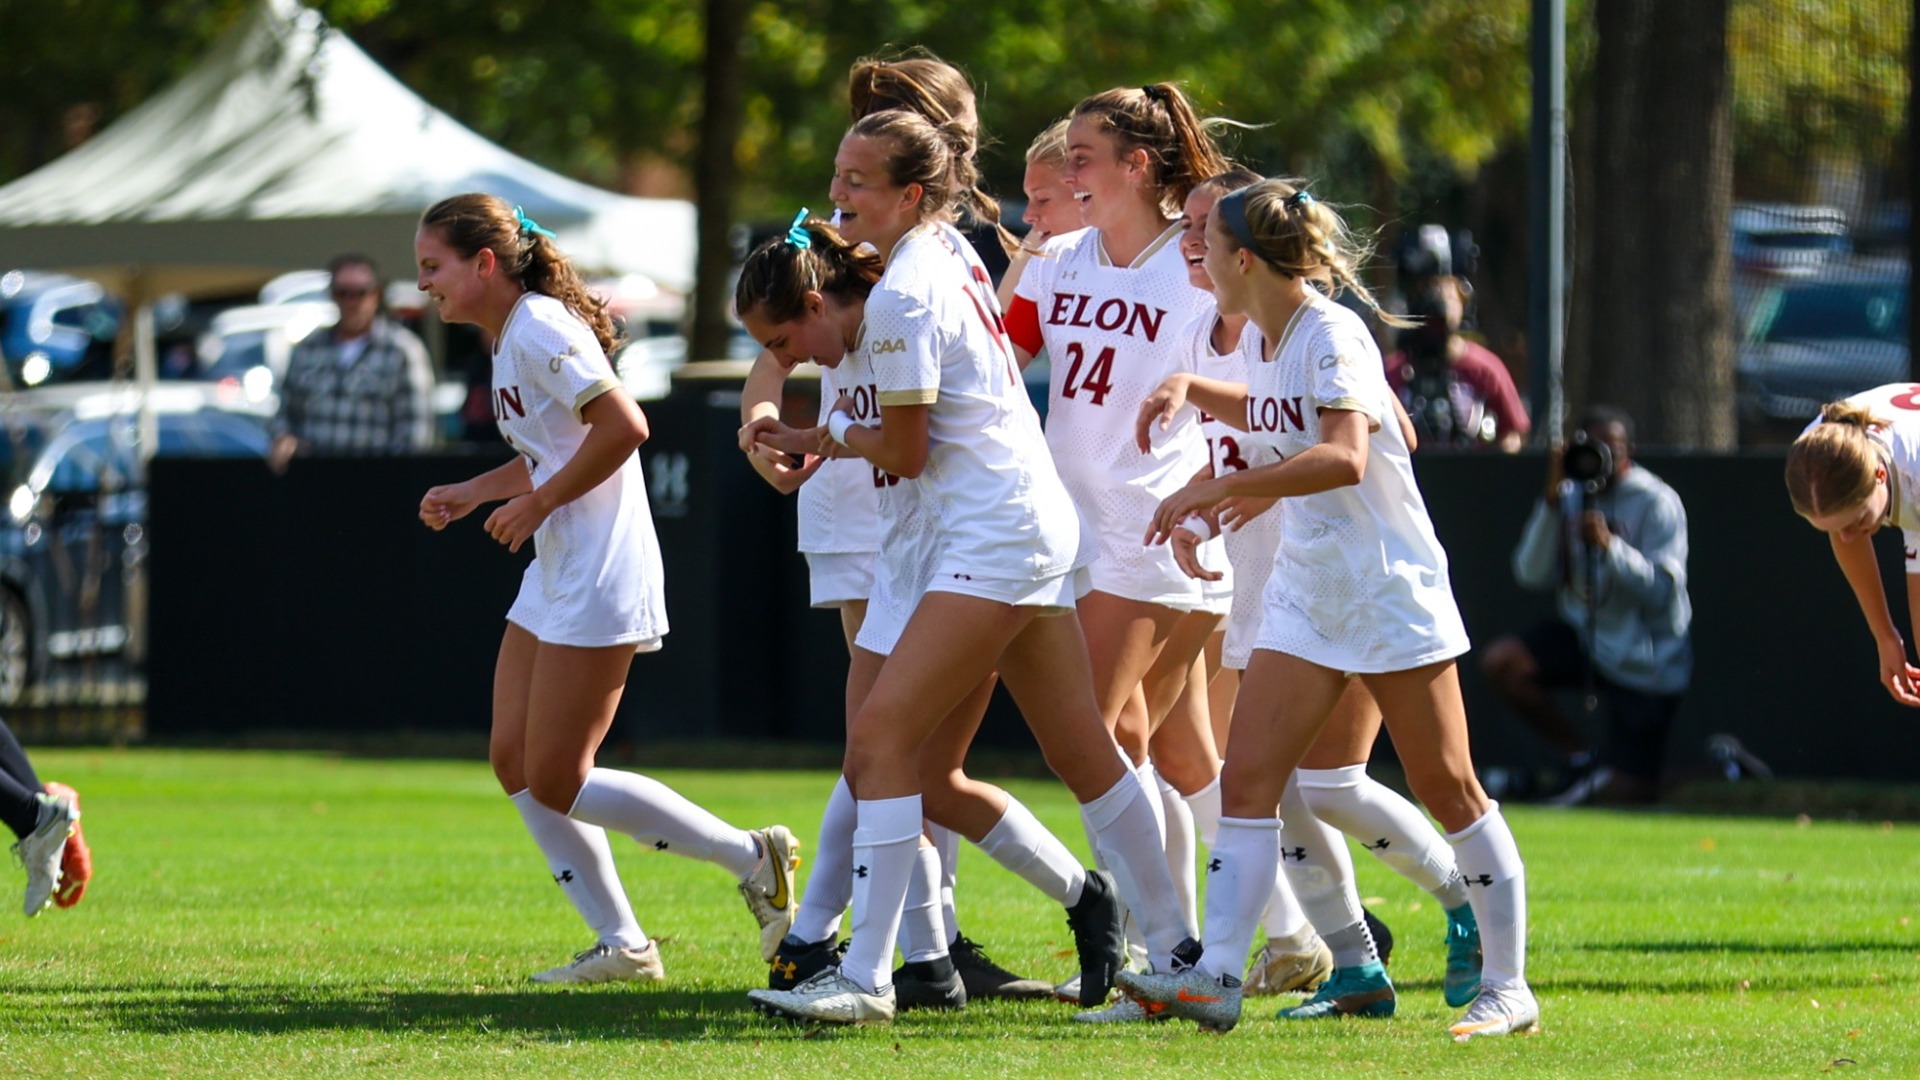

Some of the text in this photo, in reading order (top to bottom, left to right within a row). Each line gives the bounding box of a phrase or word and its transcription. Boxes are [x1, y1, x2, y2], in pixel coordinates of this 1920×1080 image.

[1046, 292, 1168, 343] ELON
[872, 338, 907, 354] CAA
[1062, 341, 1116, 406] 24
[1250, 396, 1305, 433] LON
[1206, 435, 1249, 479] 13
